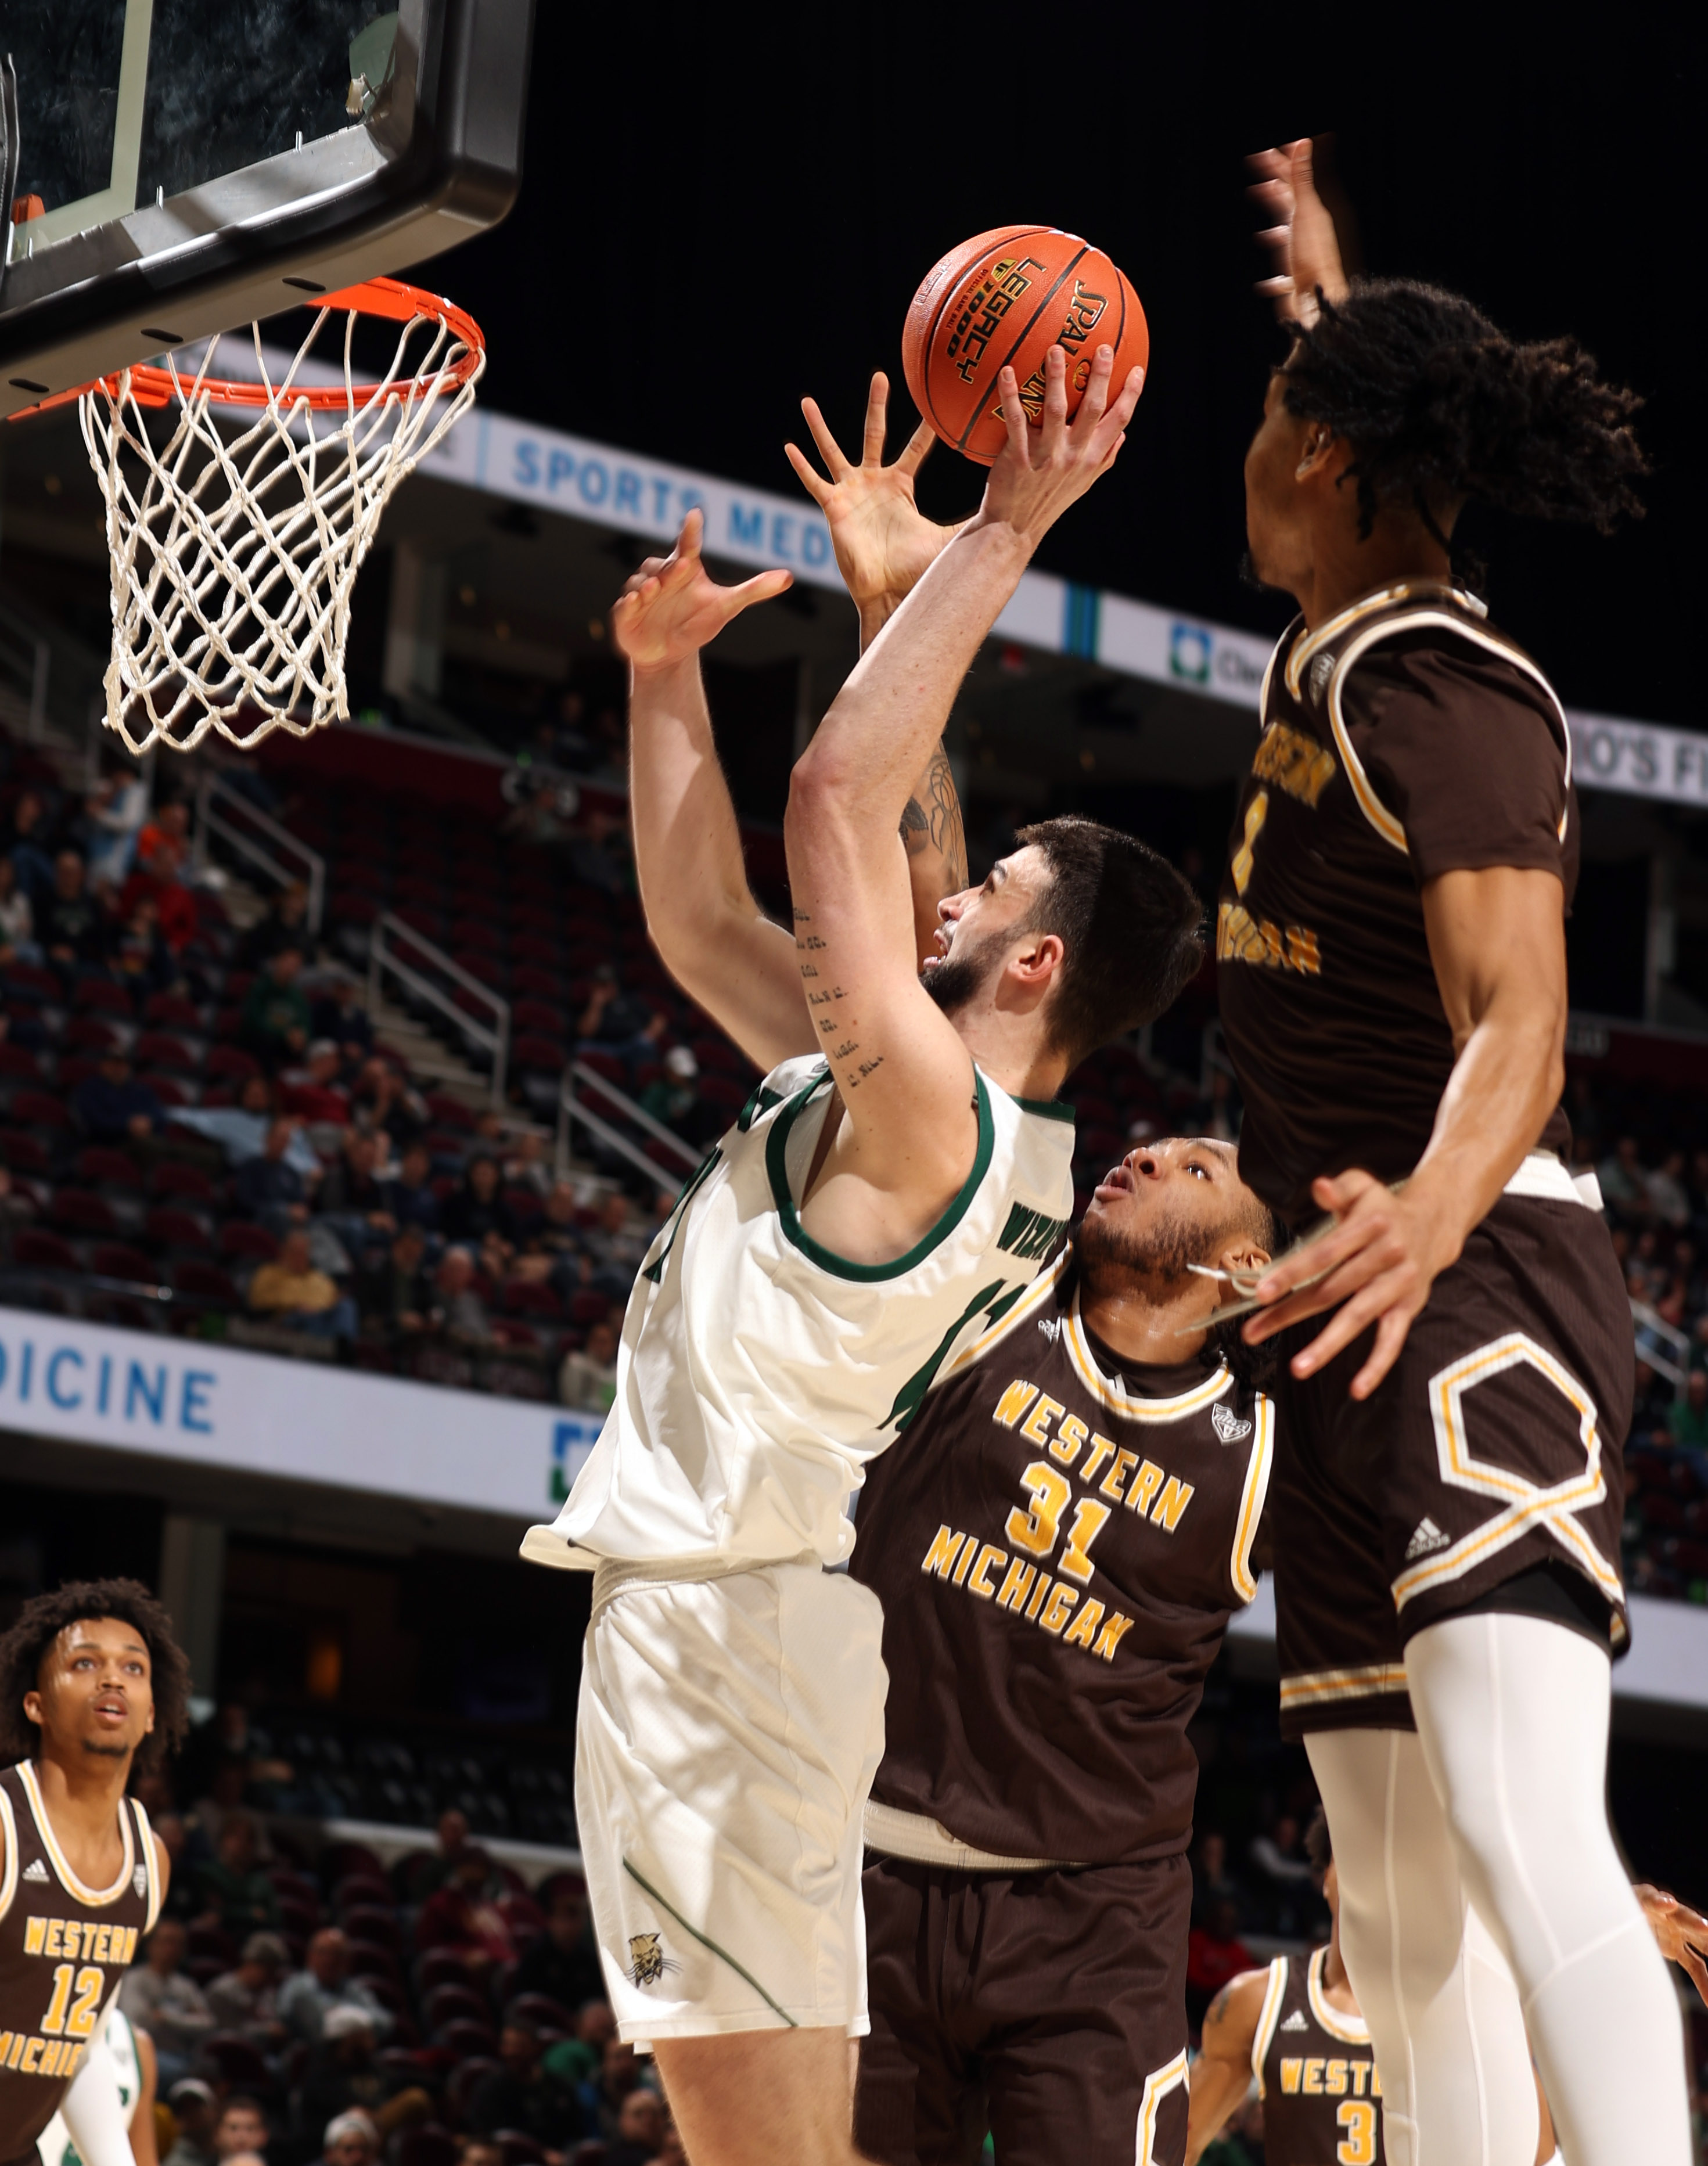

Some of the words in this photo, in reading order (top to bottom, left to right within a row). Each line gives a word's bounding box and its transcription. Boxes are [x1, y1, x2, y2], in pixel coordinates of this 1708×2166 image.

[947, 280, 994, 359] 1000
[955, 256, 1047, 385] LEGACY
[992, 1379, 1195, 1535] WESTERN
[1005, 1460, 1112, 1587] 31
[921, 1524, 1135, 1663] MICHIGAN
[24, 1916, 139, 1964] WESTERN
[40, 1963, 105, 2038] 12
[1337, 2099, 1377, 2166] 3
